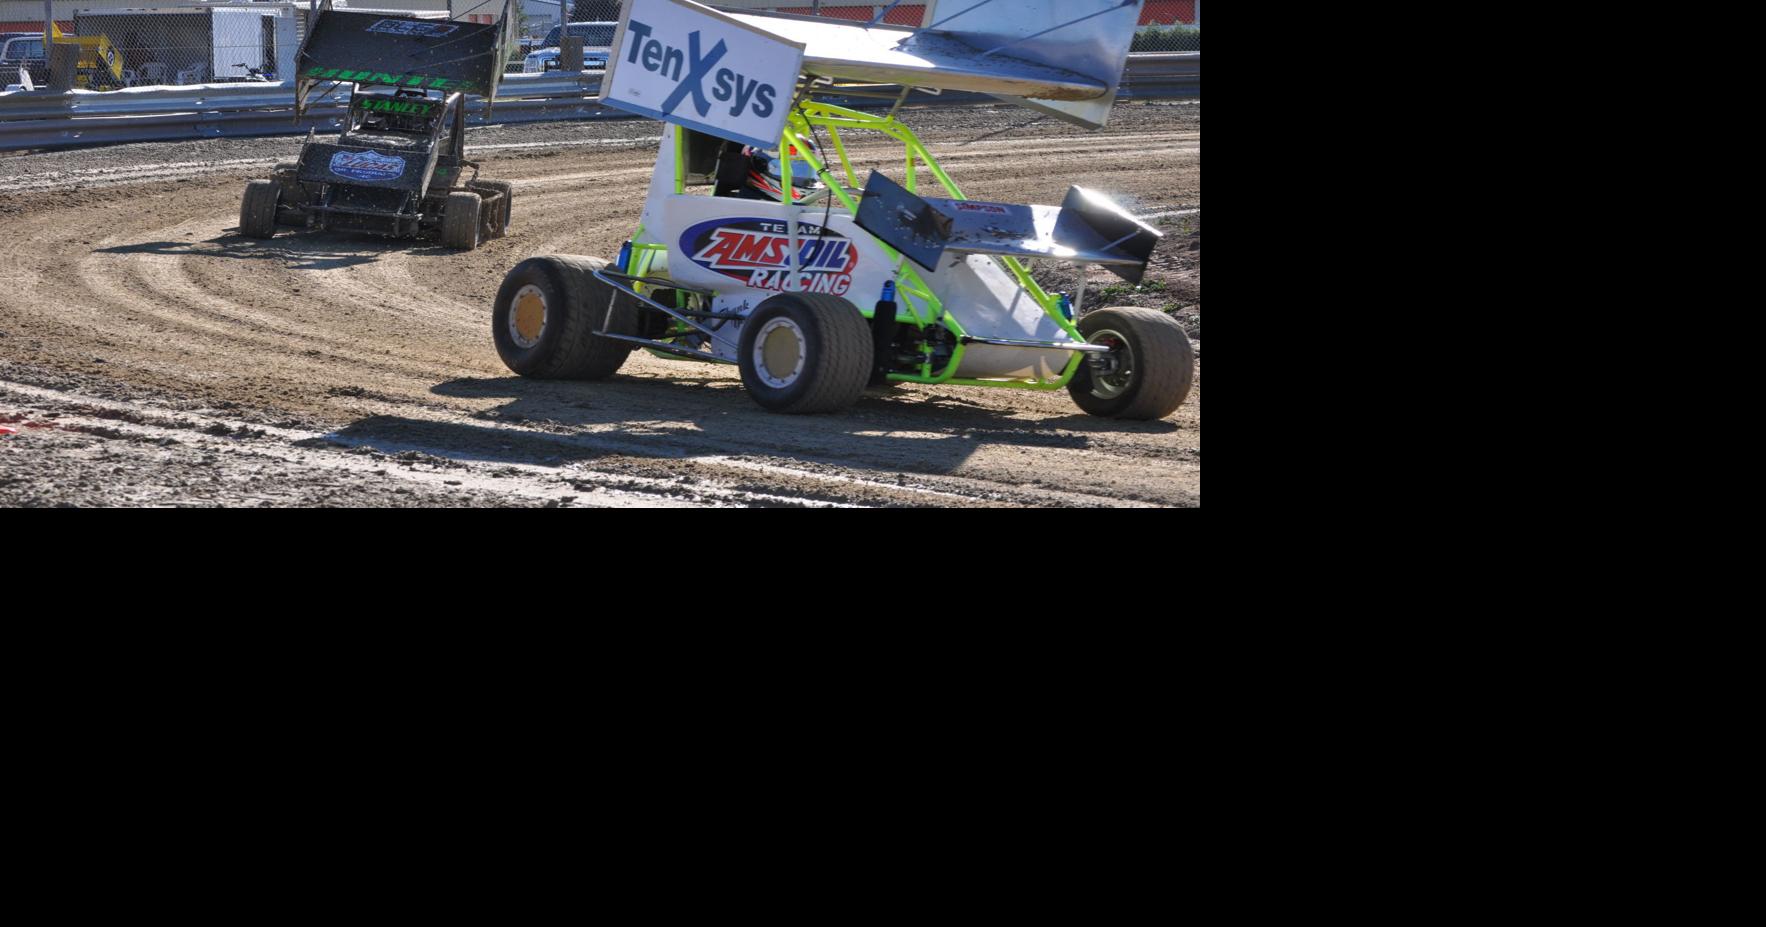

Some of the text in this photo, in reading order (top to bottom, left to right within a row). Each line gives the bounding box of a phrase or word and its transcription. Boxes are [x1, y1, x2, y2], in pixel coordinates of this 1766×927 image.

[627, 19, 776, 119] TenXsys
[361, 98, 432, 115] STANLEY
[760, 222, 821, 235] TEAM
[702, 231, 851, 269] AMSOIL
[748, 269, 851, 296] RACING
